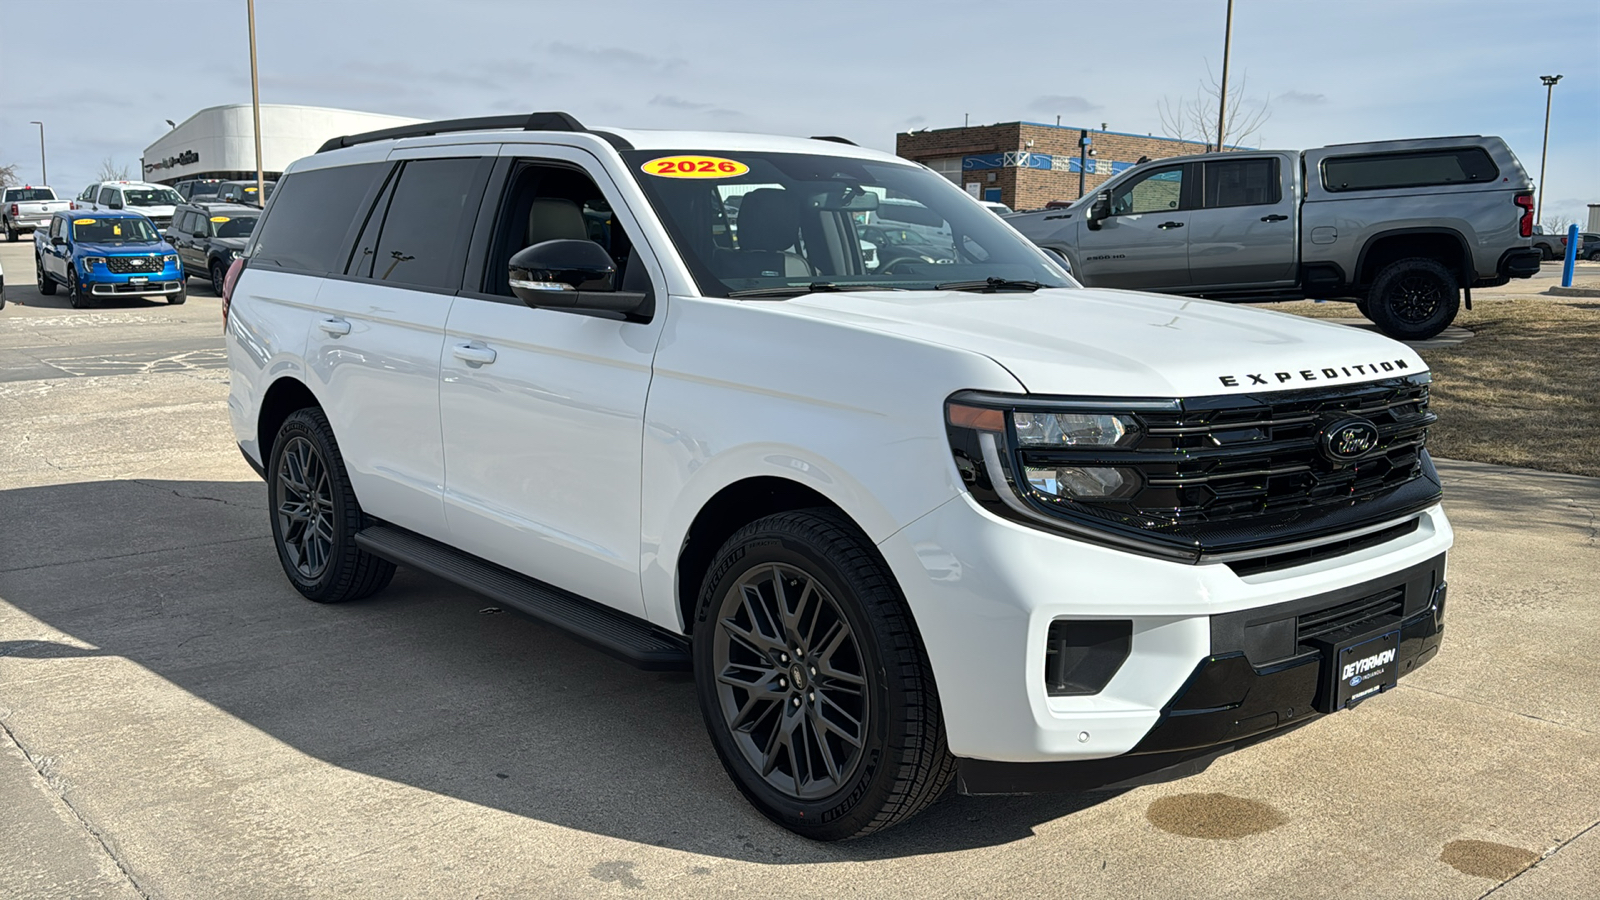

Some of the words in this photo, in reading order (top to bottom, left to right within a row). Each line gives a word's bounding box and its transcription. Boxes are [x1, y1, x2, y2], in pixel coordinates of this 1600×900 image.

[656, 160, 736, 174] 2026
[1218, 359, 1409, 387] EXPEDITION
[1338, 427, 1371, 454] Ford
[705, 546, 745, 603] MICHELIN
[1342, 648, 1396, 680] DEYARMAN
[822, 772, 872, 823] MICHELIN
